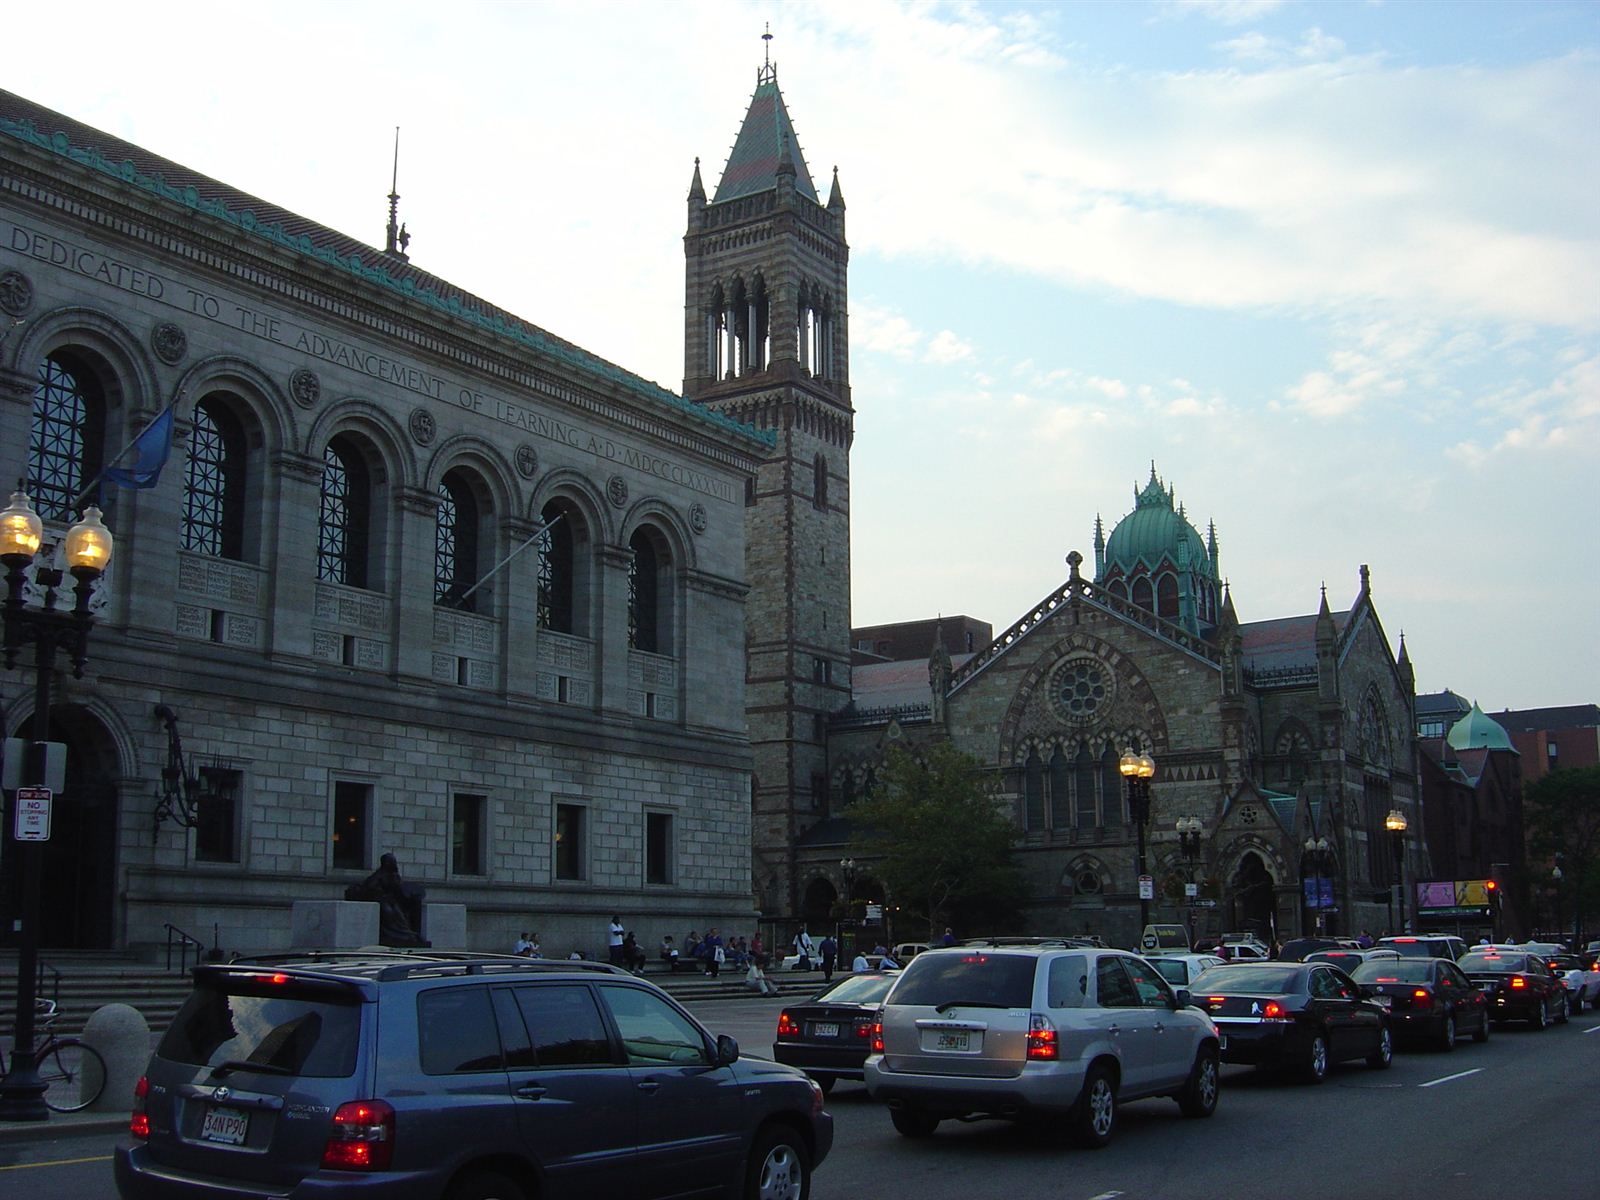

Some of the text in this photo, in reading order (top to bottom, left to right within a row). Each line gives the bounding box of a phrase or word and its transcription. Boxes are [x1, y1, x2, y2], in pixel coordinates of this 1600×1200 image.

[11, 227, 164, 299] DEDICATED
[187, 289, 220, 318] TO
[236, 307, 281, 342] THE
[295, 332, 445, 398] ADVANCEMENT
[459, 390, 483, 410] OF
[495, 402, 579, 447] LEARNING
[27, 801, 41, 809] NO
[225, 1117, 246, 1137] P90
